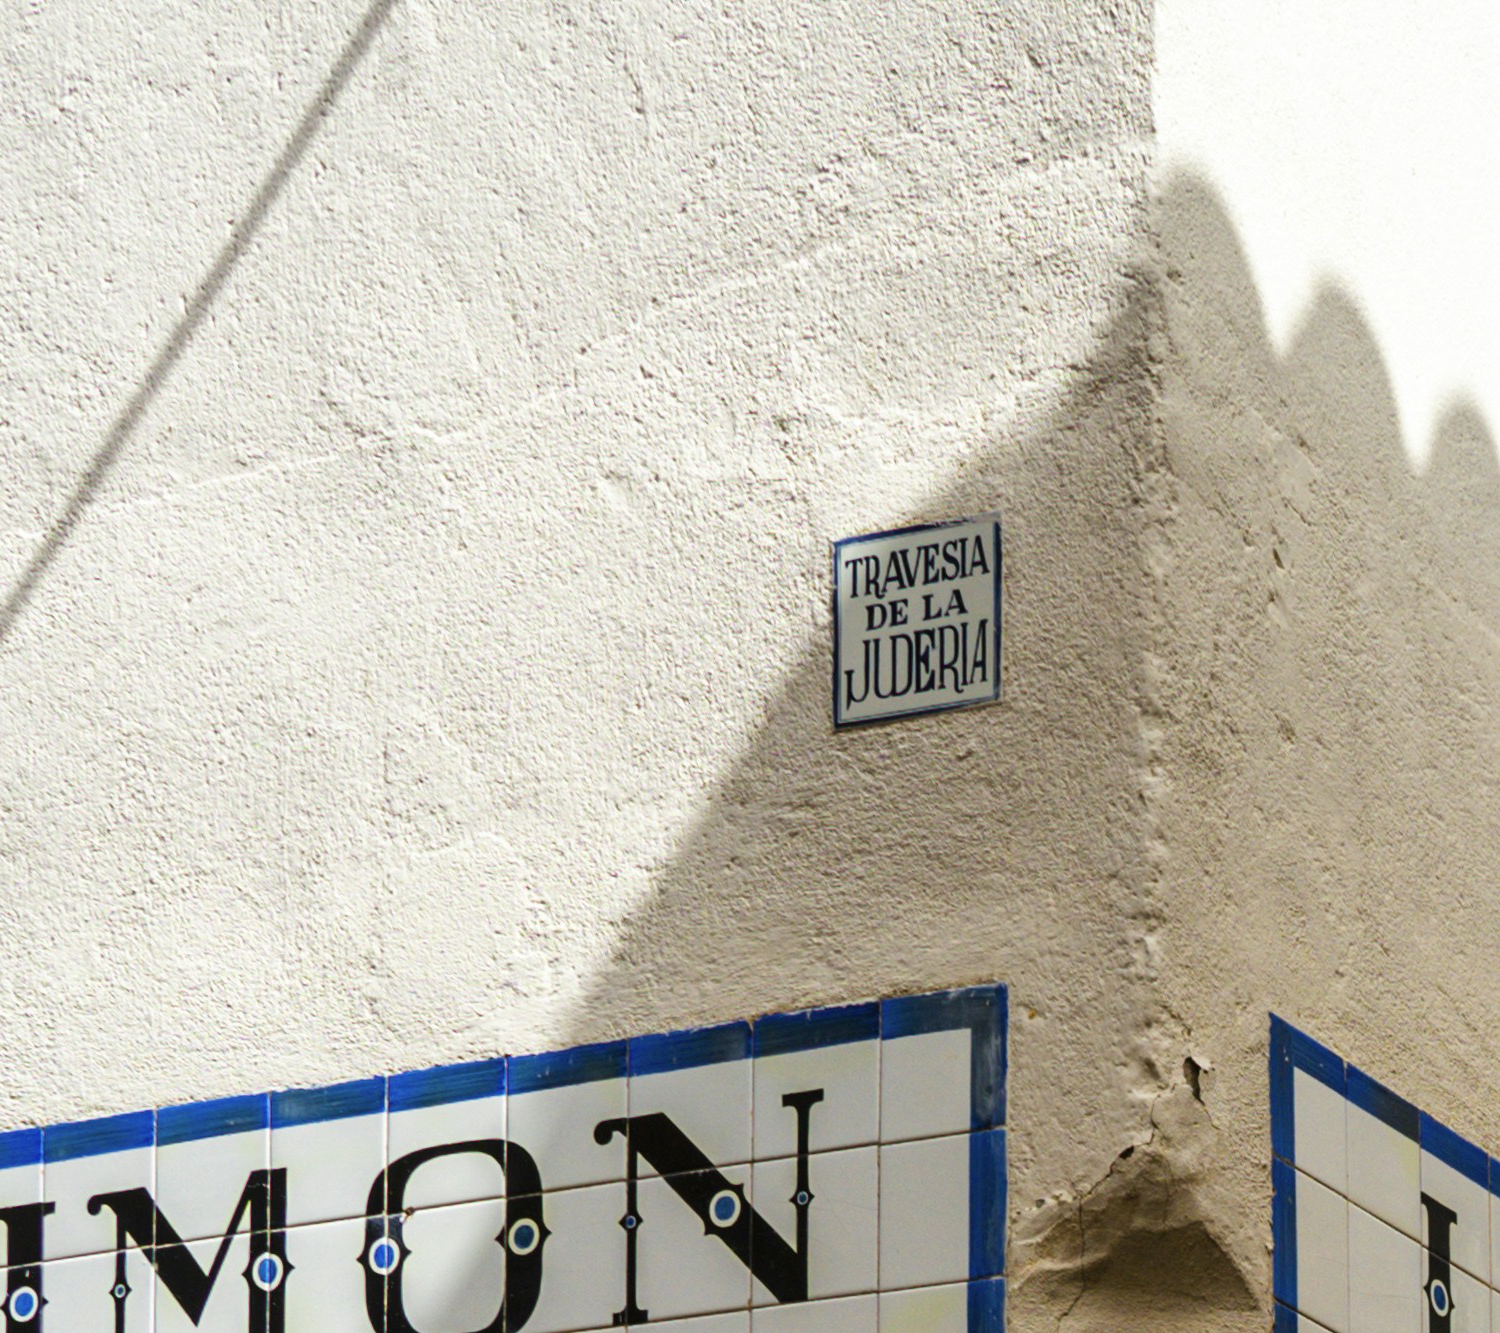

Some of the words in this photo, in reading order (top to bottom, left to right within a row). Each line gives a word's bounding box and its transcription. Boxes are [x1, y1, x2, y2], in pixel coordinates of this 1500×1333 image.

[844, 534, 990, 599] TRAVESIA
[865, 598, 909, 631] DE
[922, 588, 968, 621] LA
[844, 618, 988, 710] JUDERIA
